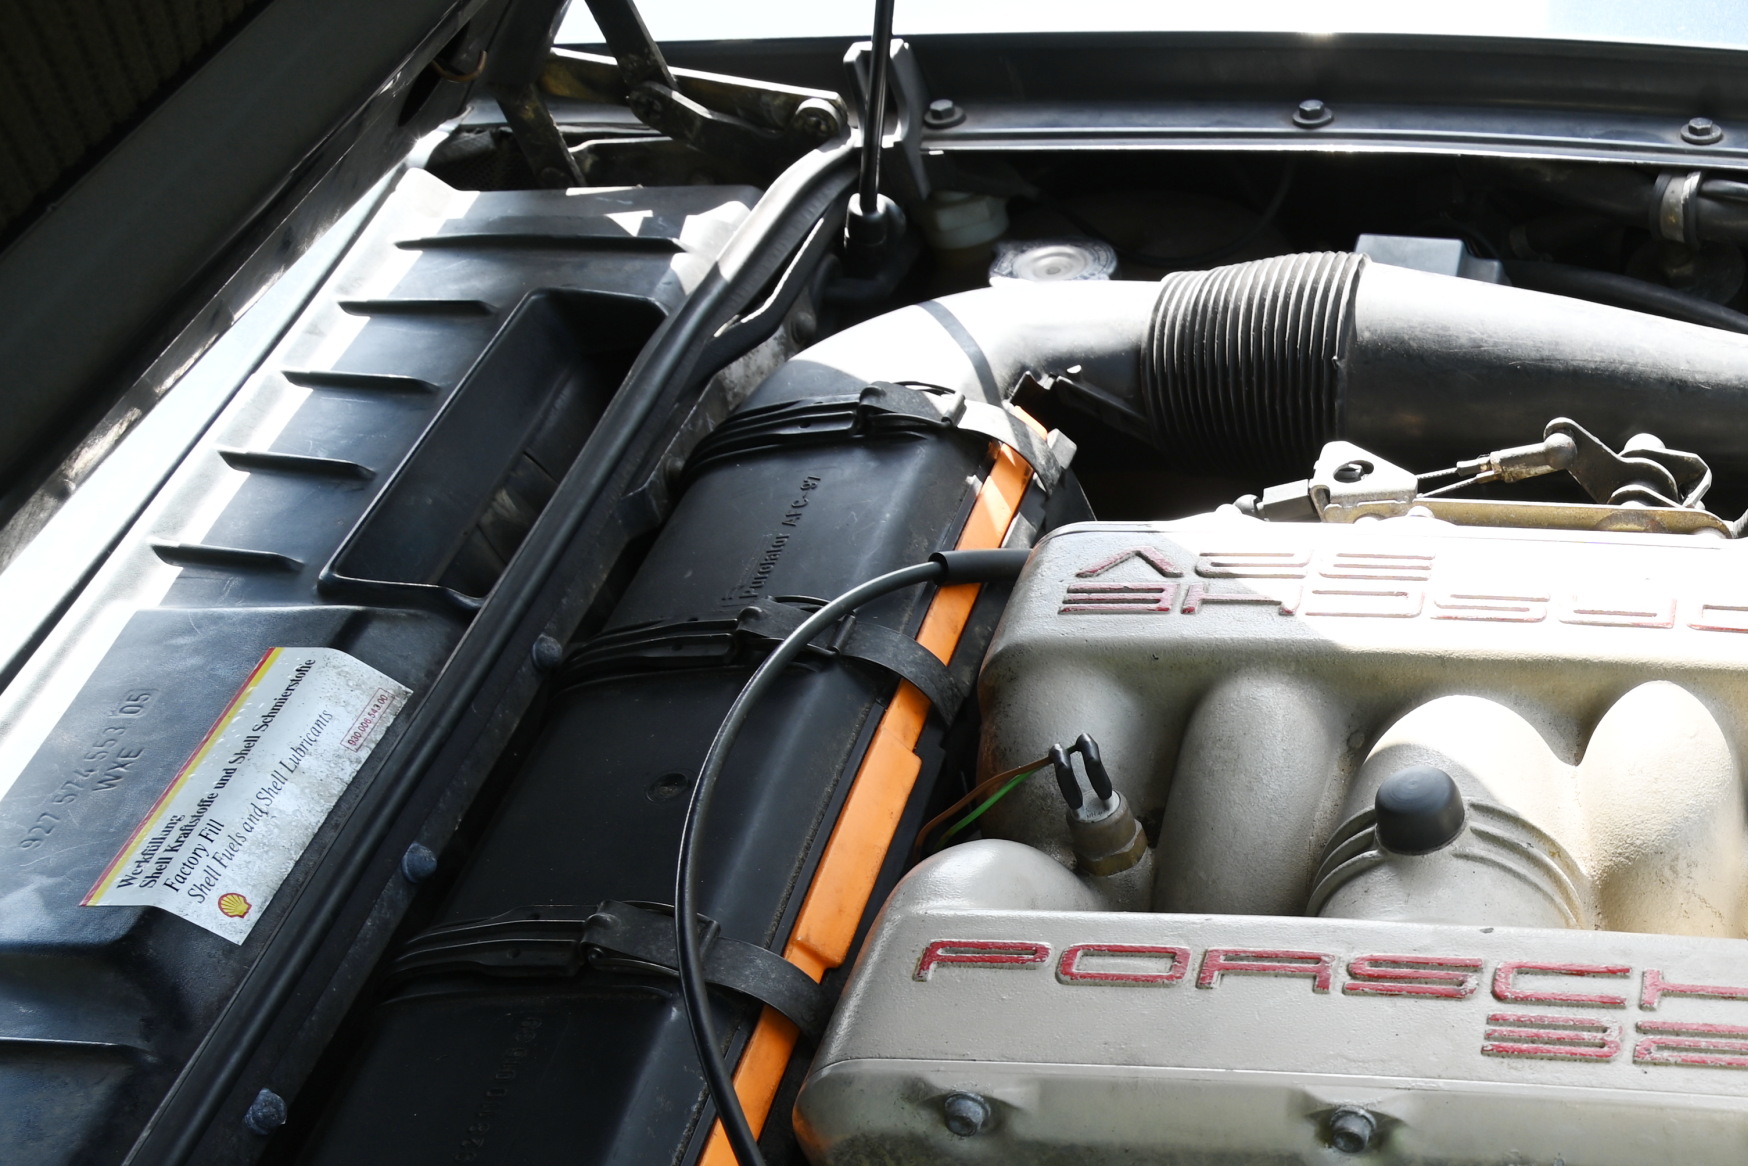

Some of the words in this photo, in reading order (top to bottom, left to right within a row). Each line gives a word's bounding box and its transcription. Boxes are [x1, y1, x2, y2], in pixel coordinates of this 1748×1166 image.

[19, 812, 60, 849] 927
[138, 849, 174, 888] Shell
[165, 792, 219, 853] Kraftstoffe
[214, 766, 238, 789] und
[228, 734, 261, 766] Shell
[162, 843, 210, 893] Factory
[198, 818, 225, 844] Fill
[186, 863, 222, 905] Shell
[211, 831, 247, 869] Fuels
[242, 802, 268, 833] and
[255, 769, 288, 807] Shell
[278, 709, 333, 774] Lubricants
